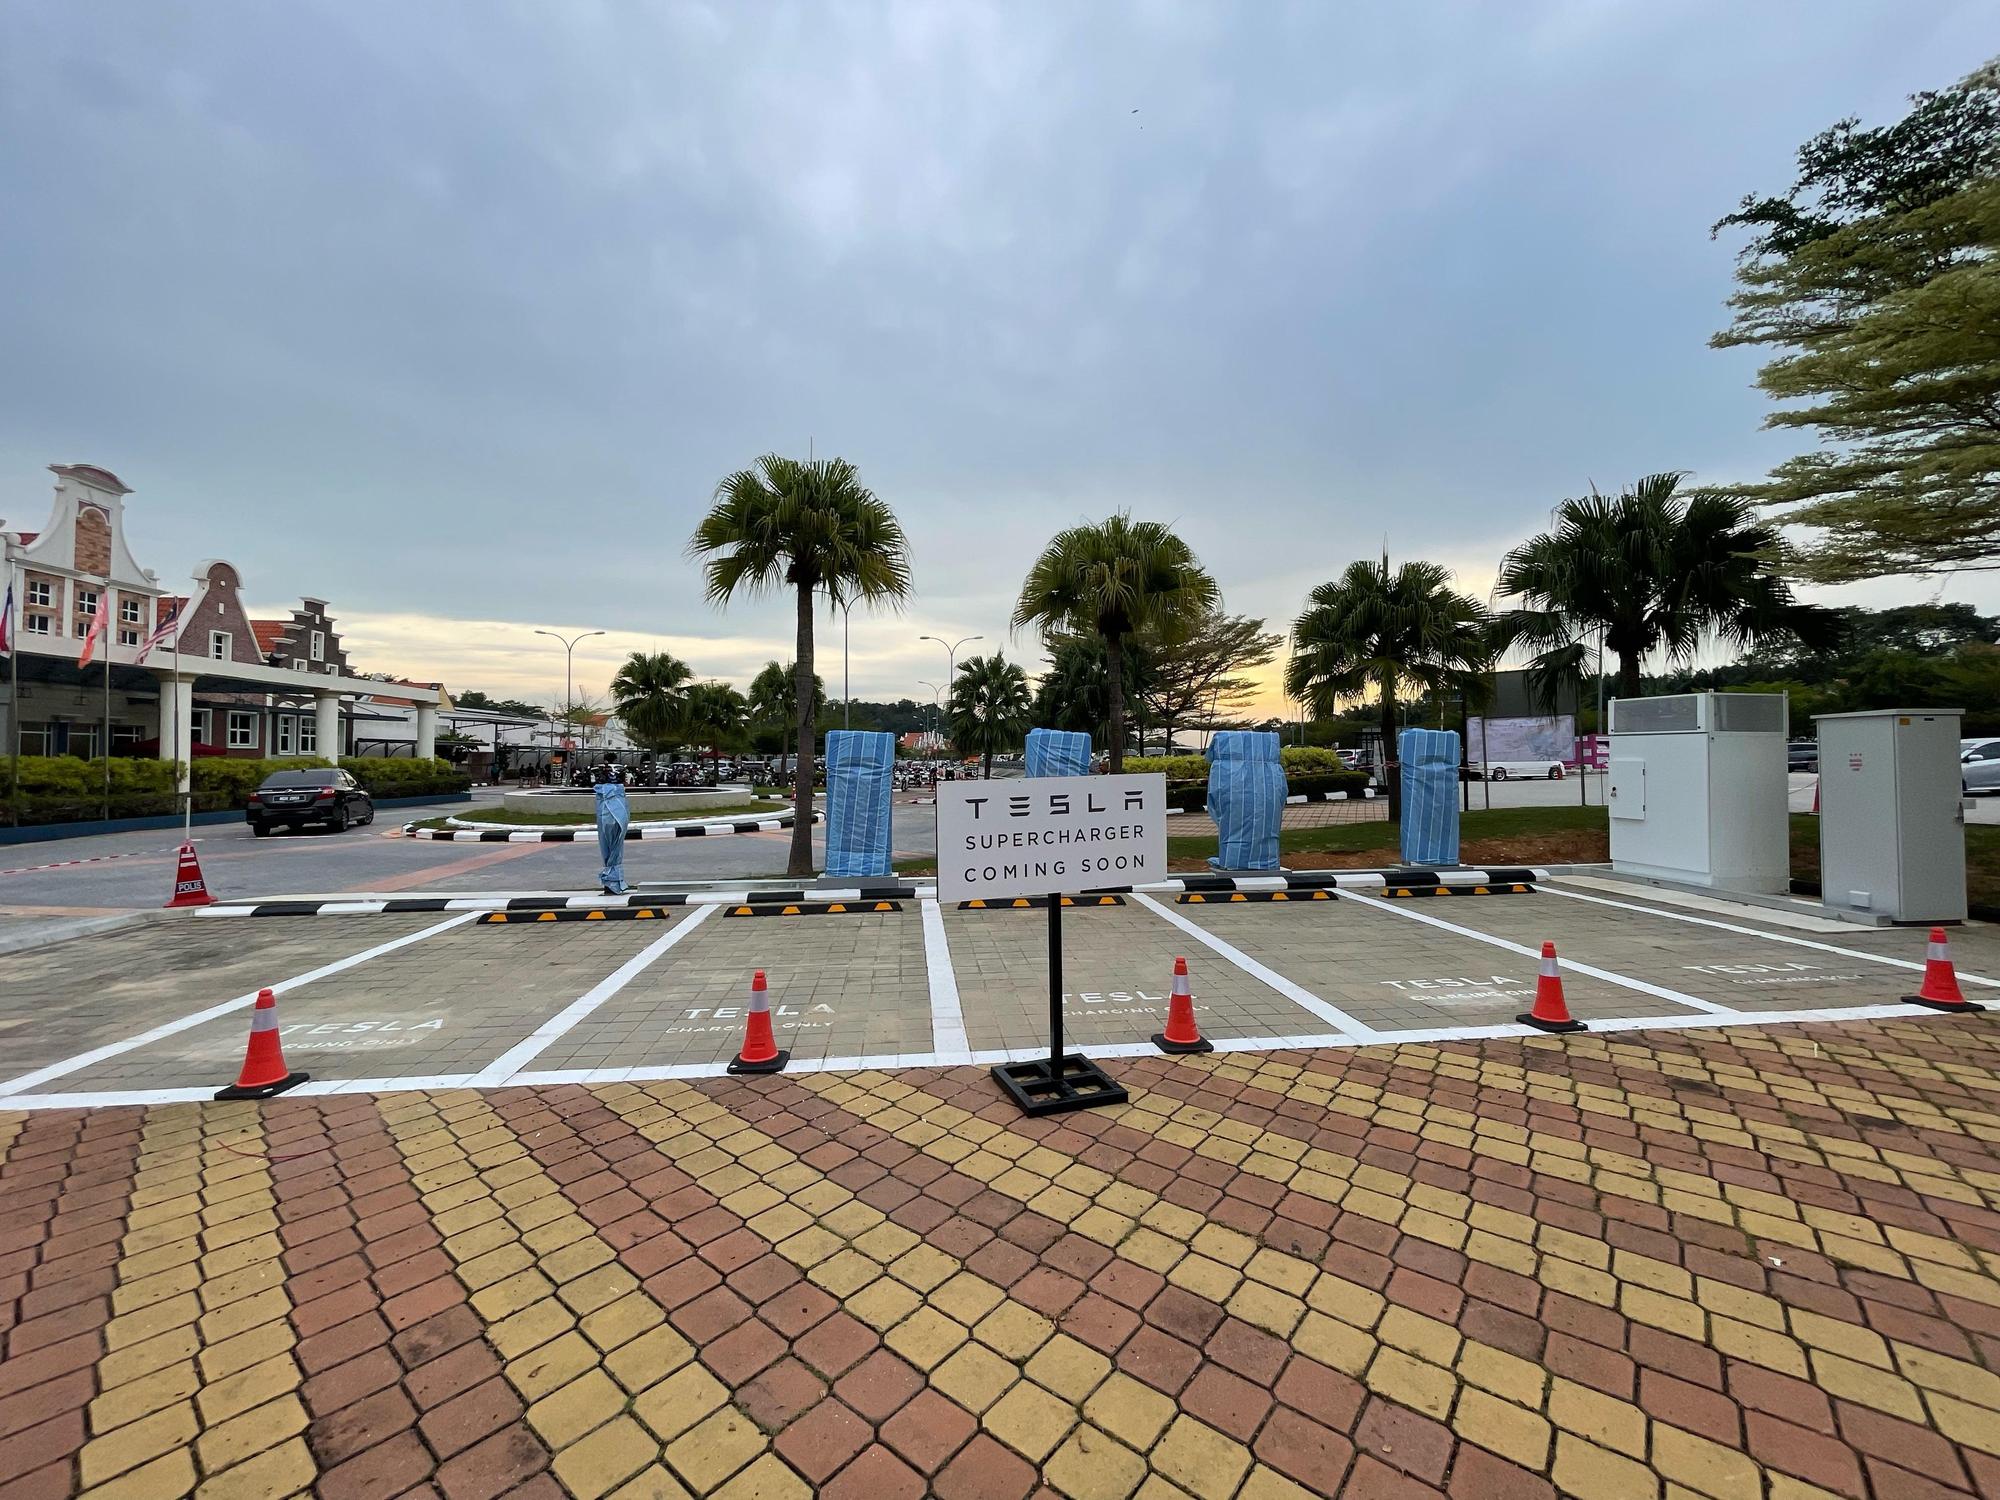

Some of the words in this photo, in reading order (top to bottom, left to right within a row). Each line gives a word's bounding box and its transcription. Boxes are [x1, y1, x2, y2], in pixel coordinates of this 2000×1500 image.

[965, 790, 1144, 819] TESLA
[966, 824, 1144, 850] SUPERCHARGER
[964, 860, 1066, 883] COMING
[1081, 854, 1145, 873] SOON
[178, 881, 202, 892] POLIS
[1682, 962, 1823, 975] TESLA
[1380, 975, 1524, 990] TESLA
[684, 1003, 836, 1020] TELA
[280, 1018, 444, 1036] TESLA
[665, 1025, 748, 1034] CHARGI
[782, 1021, 835, 1029] ONLY
